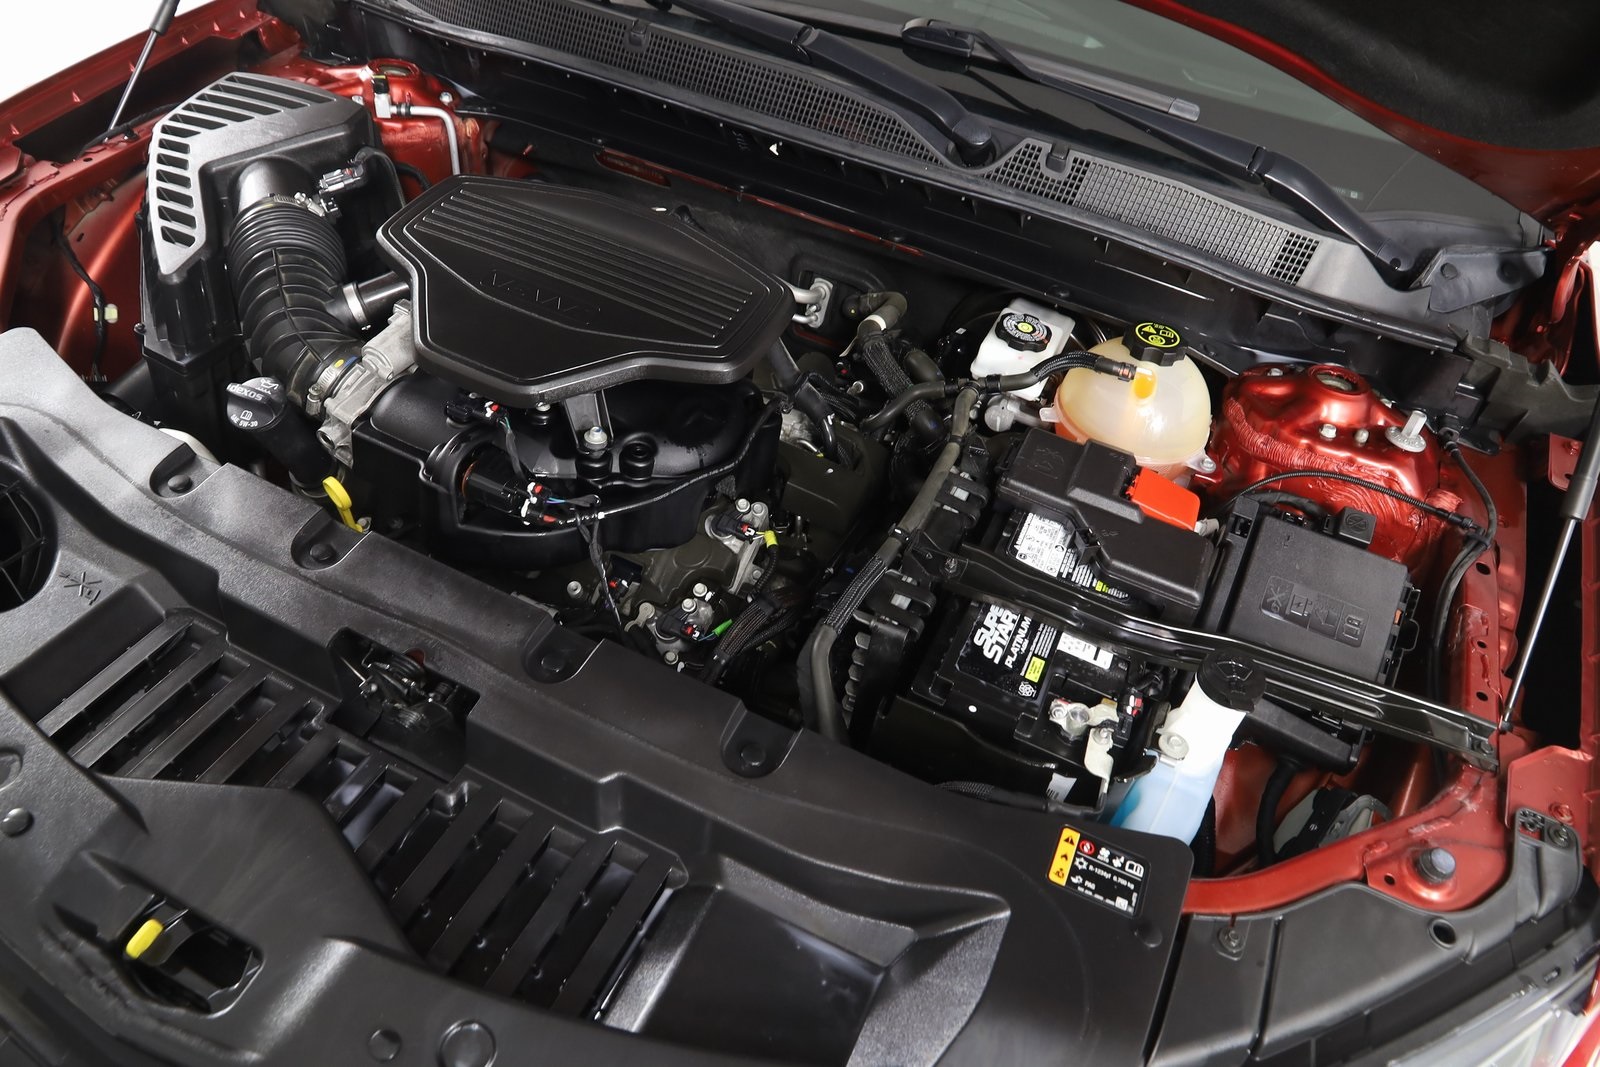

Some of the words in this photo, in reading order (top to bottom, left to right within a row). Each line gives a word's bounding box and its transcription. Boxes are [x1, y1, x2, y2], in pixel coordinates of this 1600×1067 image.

[230, 384, 264, 401] dexos
[973, 604, 1004, 650] SUPE
[983, 609, 1018, 665] STAR
[1004, 616, 1032, 668] PLATINUM
